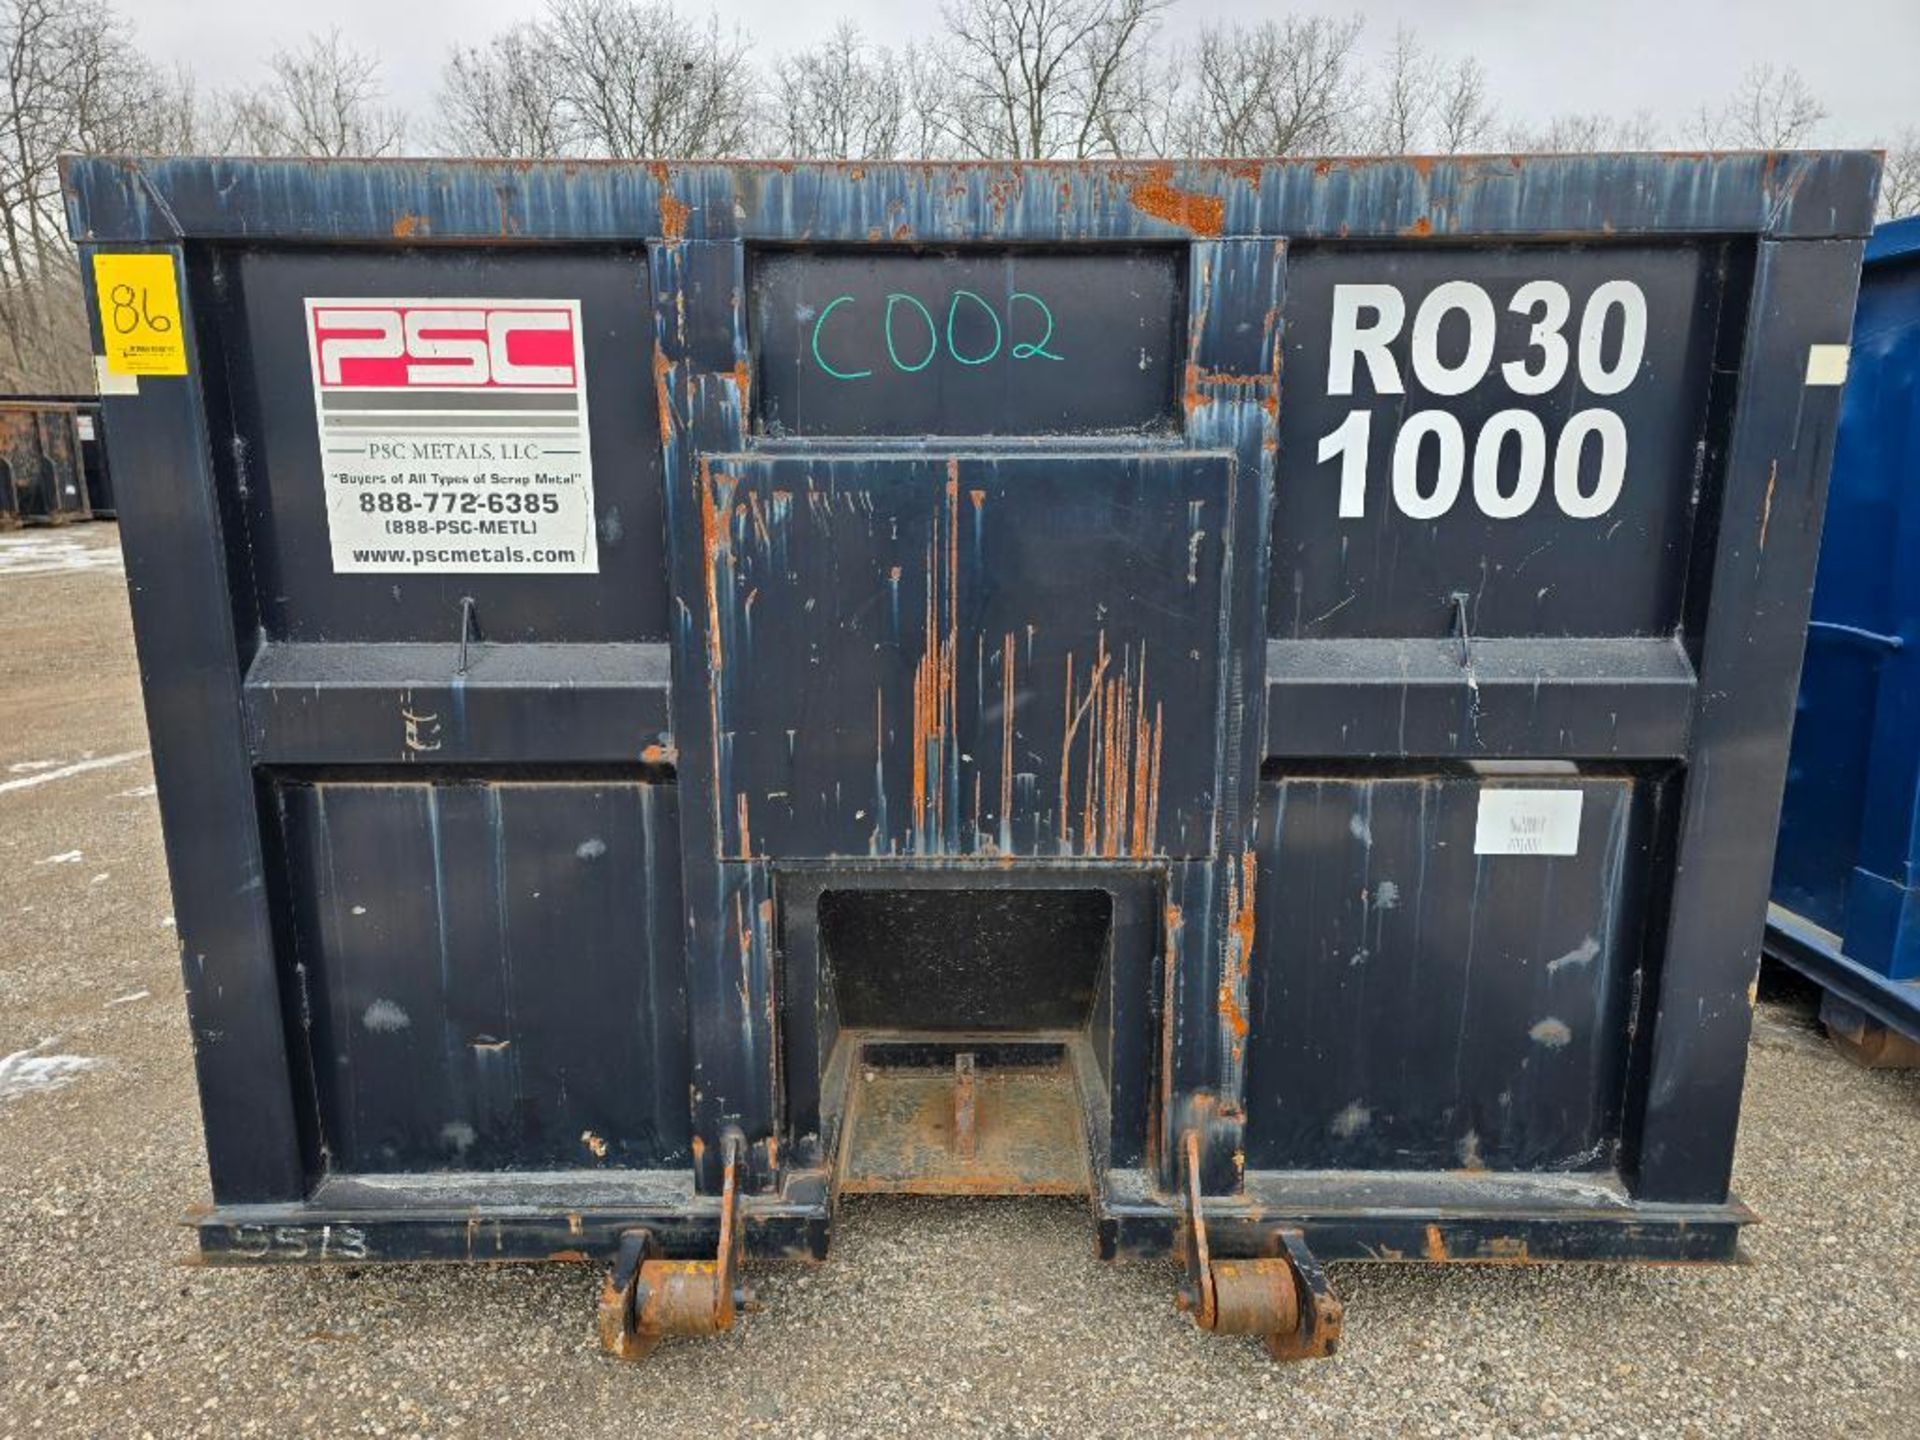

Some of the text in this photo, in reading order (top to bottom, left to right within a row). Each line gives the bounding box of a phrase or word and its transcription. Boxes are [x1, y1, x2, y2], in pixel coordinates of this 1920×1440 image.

[112, 284, 171, 334] 86
[317, 310, 574, 385] PSC
[813, 290, 1065, 379] C002
[1327, 280, 1648, 396] RO30
[368, 443, 539, 461] PSC METALS, LLC
[1315, 408, 1628, 520] 1000
[391, 473, 404, 484] of
[408, 473, 426, 484] All
[431, 473, 469, 487] Types
[473, 473, 486, 484] of
[490, 473, 530, 486] Scrap
[359, 492, 560, 514] 888-772-6385
[385, 519, 537, 535] (888-PSC-METL)
[353, 547, 576, 566] www.pscmetals.com
